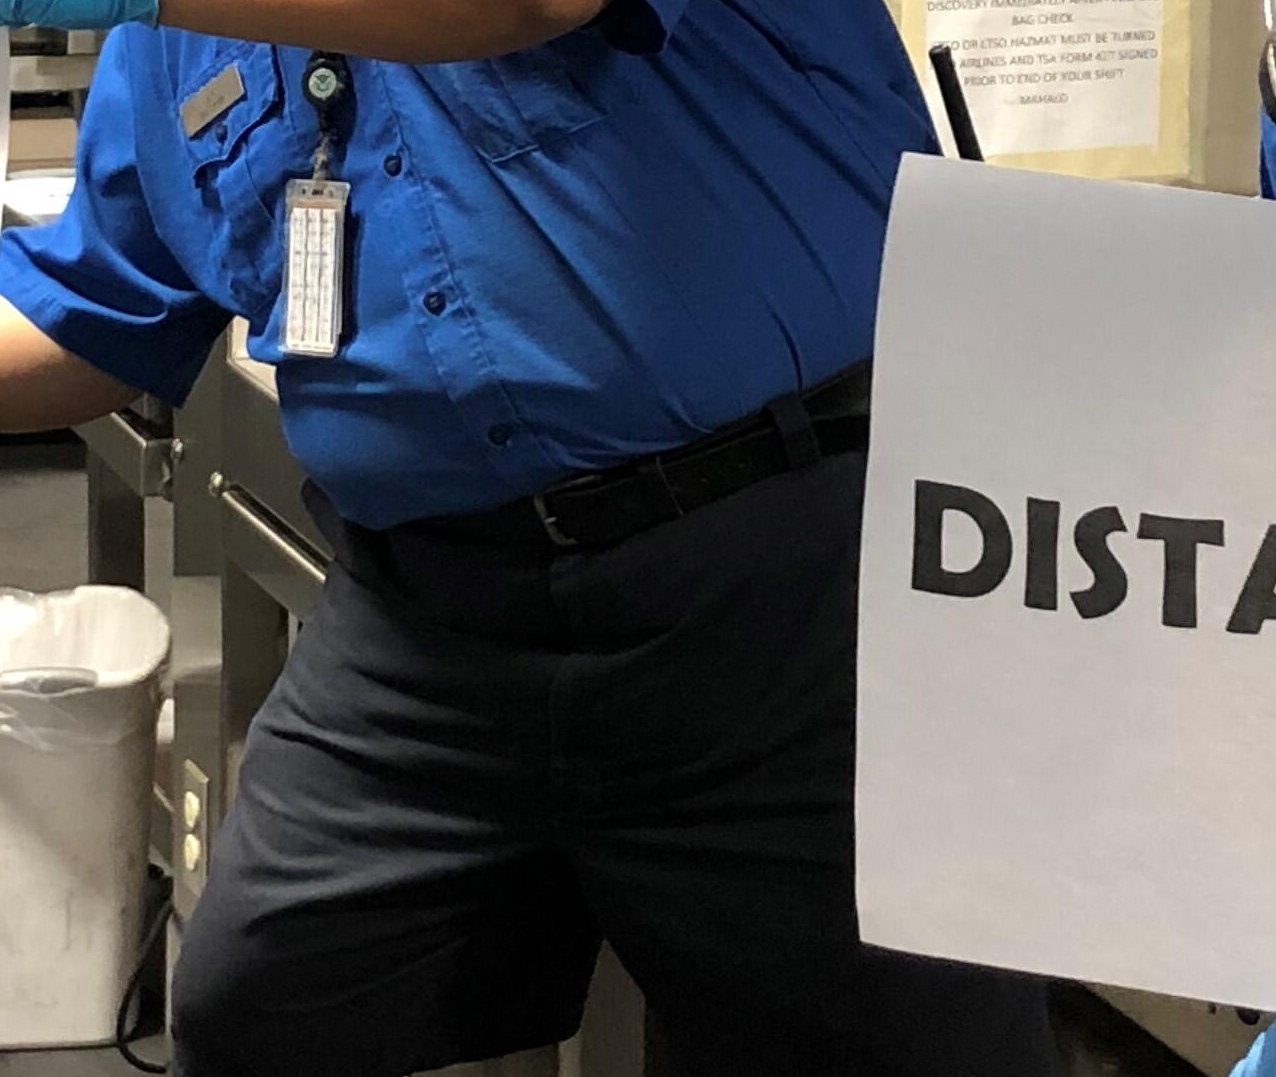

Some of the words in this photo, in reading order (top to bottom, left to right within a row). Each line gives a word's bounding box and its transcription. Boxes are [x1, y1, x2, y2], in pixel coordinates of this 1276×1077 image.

[1011, 14, 1035, 26] BAG
[1037, 12, 1074, 24] CHECK
[1110, 29, 1156, 42] TURNED
[1009, 54, 1035, 66] AND
[1117, 47, 1158, 61] SIGNED
